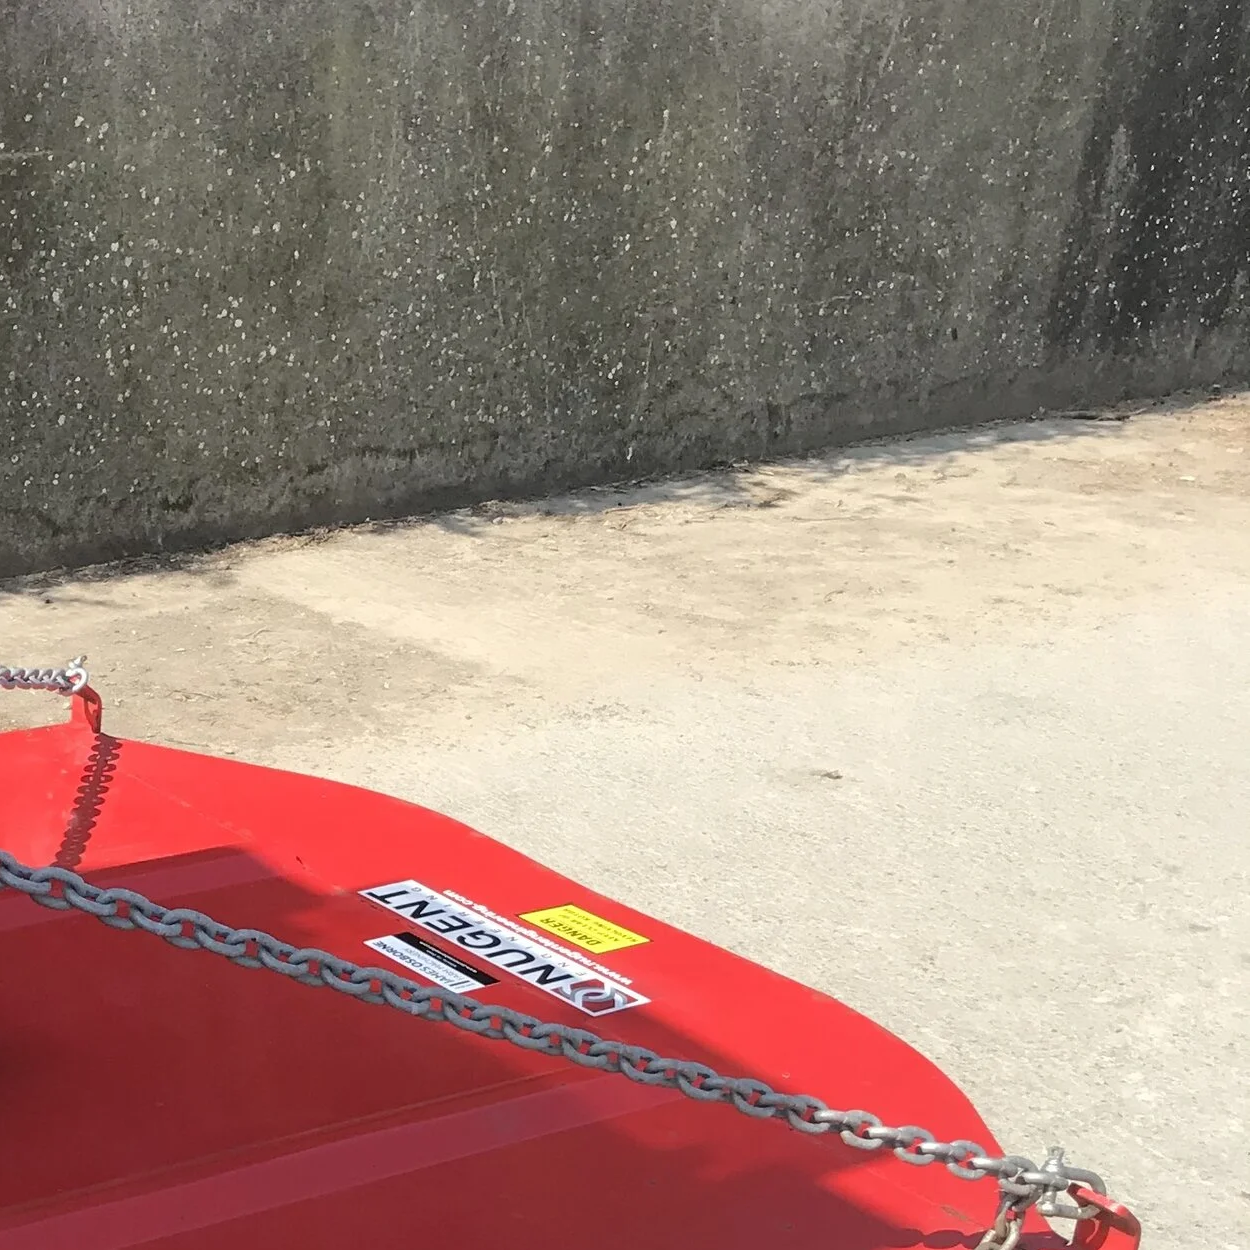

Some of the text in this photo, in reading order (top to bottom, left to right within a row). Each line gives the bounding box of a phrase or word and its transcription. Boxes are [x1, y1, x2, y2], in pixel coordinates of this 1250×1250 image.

[366, 889, 572, 986] NUGENT
[540, 917, 602, 946] DANGER
[372, 940, 423, 968] OSBORNE
